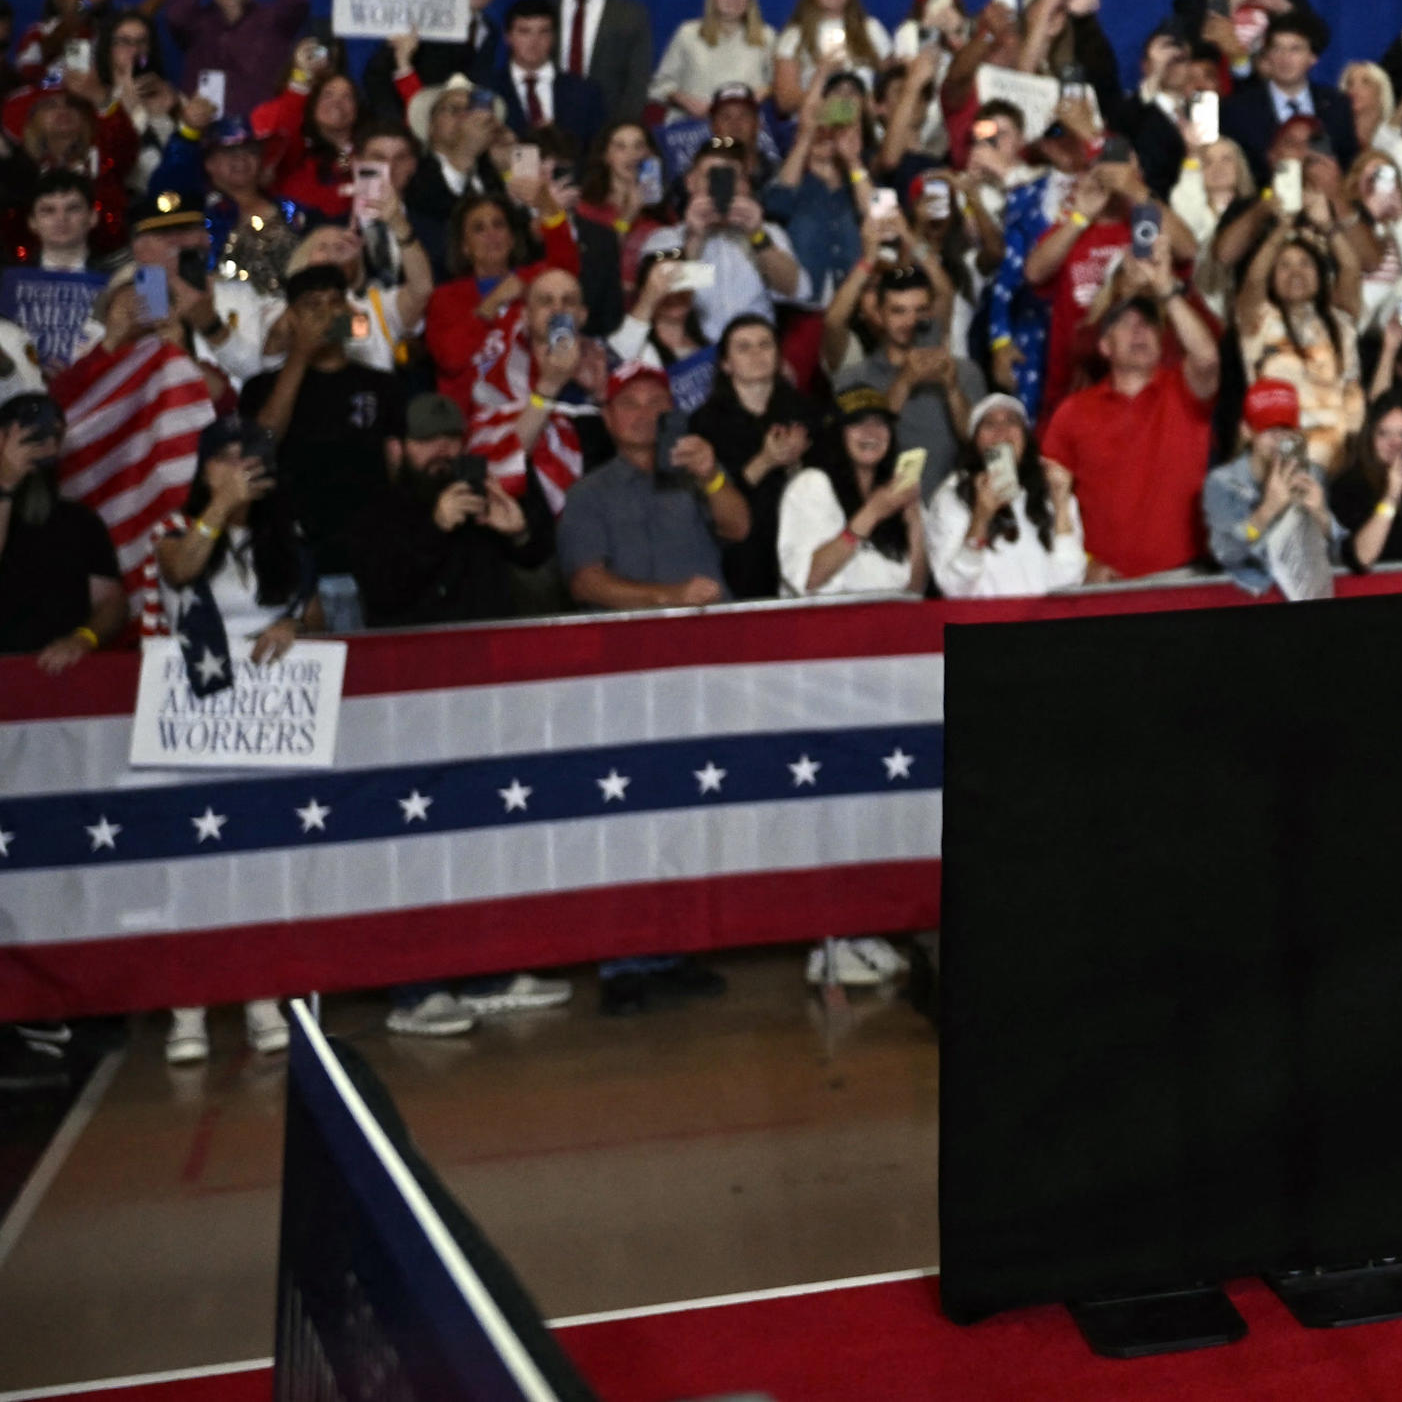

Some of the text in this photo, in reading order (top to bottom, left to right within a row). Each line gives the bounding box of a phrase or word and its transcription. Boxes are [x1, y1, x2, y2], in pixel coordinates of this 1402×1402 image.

[278, 660, 322, 682] FOR
[160, 685, 320, 717] AMERICAN
[158, 718, 316, 755] WORKERS
